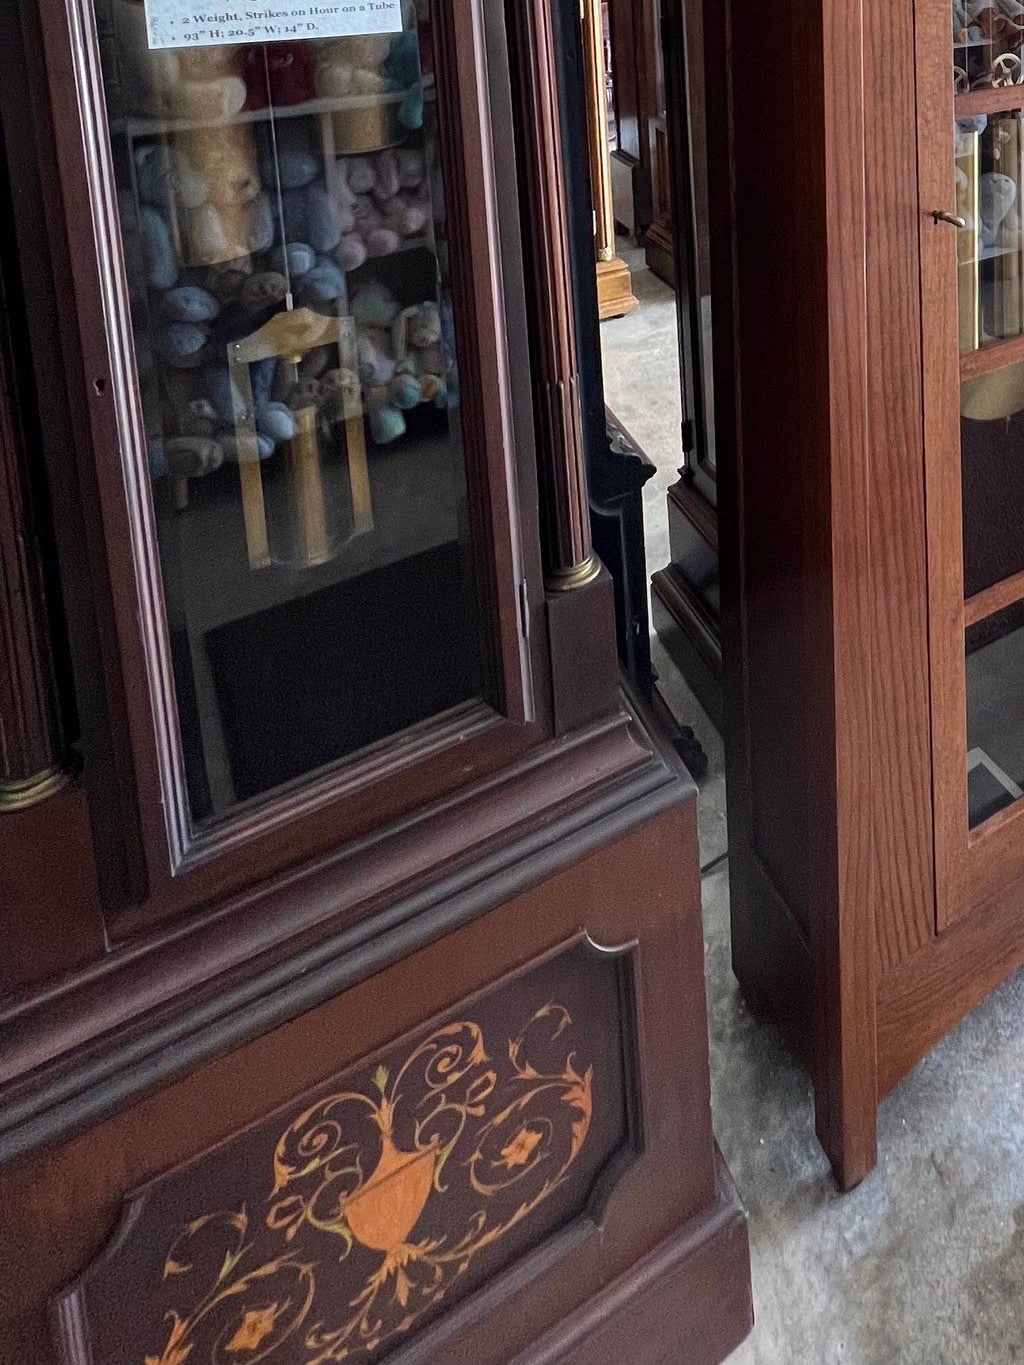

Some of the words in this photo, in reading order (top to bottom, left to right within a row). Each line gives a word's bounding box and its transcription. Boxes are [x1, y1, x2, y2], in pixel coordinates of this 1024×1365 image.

[182, 17, 190, 25] 2
[193, 13, 243, 25] Weight,
[245, 10, 288, 20] Strikes
[290, 9, 306, 17] on
[309, 6, 338, 16] Hour
[342, 5, 356, 13] on
[358, 4, 366, 12] a
[367, 1, 395, 11] Tube
